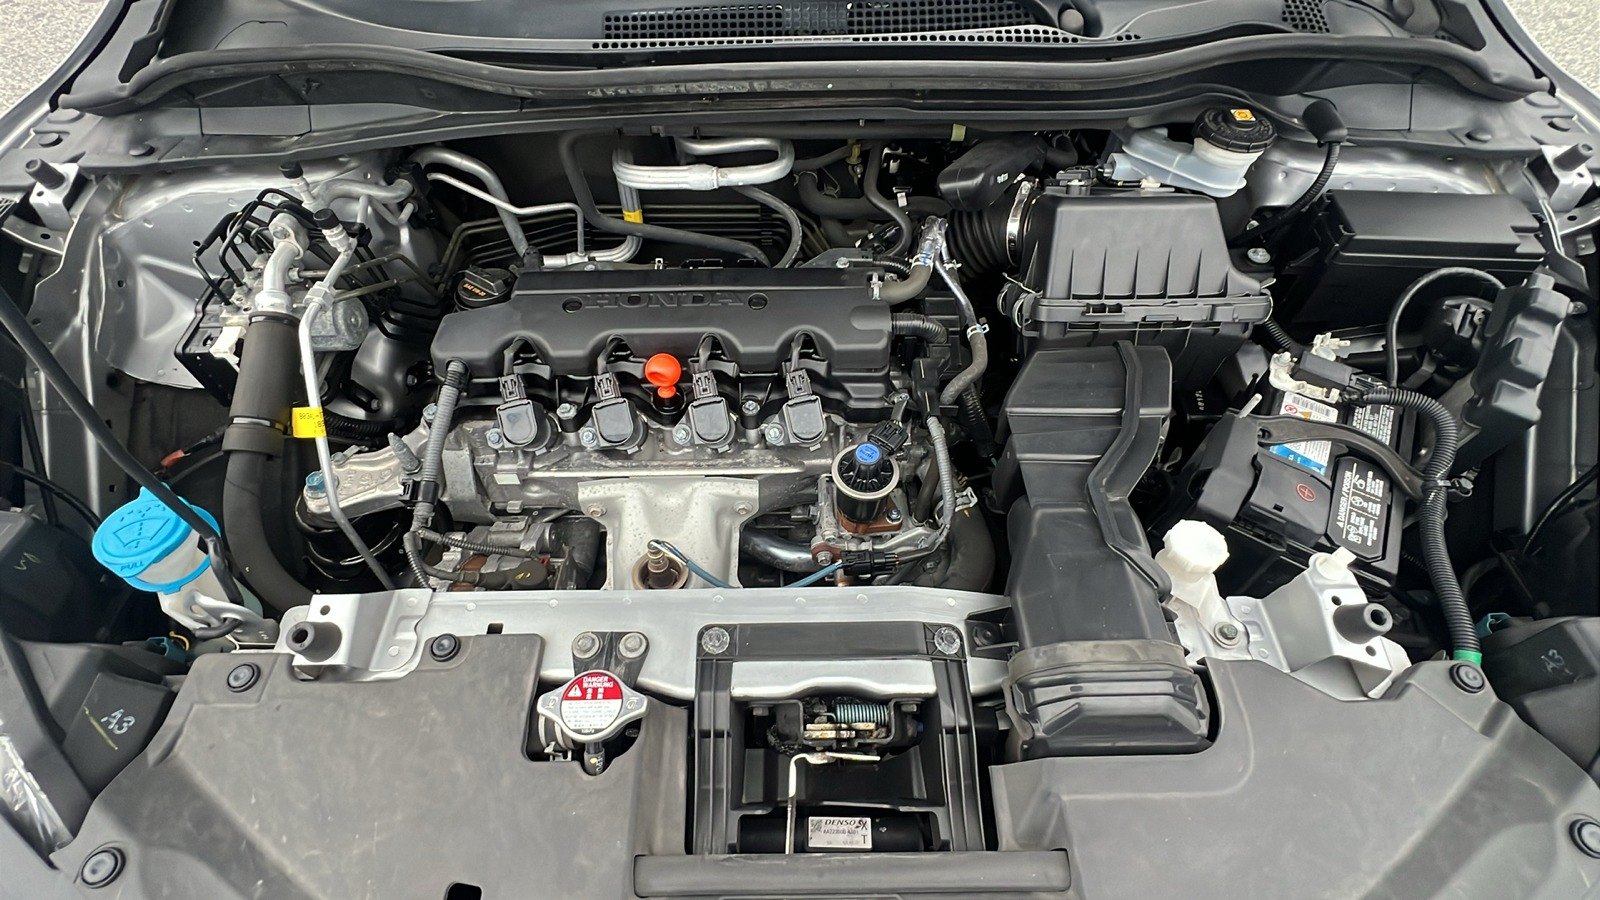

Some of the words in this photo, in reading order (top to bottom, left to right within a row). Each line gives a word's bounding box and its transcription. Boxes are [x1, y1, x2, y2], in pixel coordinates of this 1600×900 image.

[585, 292, 744, 309] HONDA
[1336, 496, 1348, 522] DANGER
[1343, 470, 1353, 493] POISON
[120, 561, 145, 572] PULL
[101, 708, 136, 735] A3
